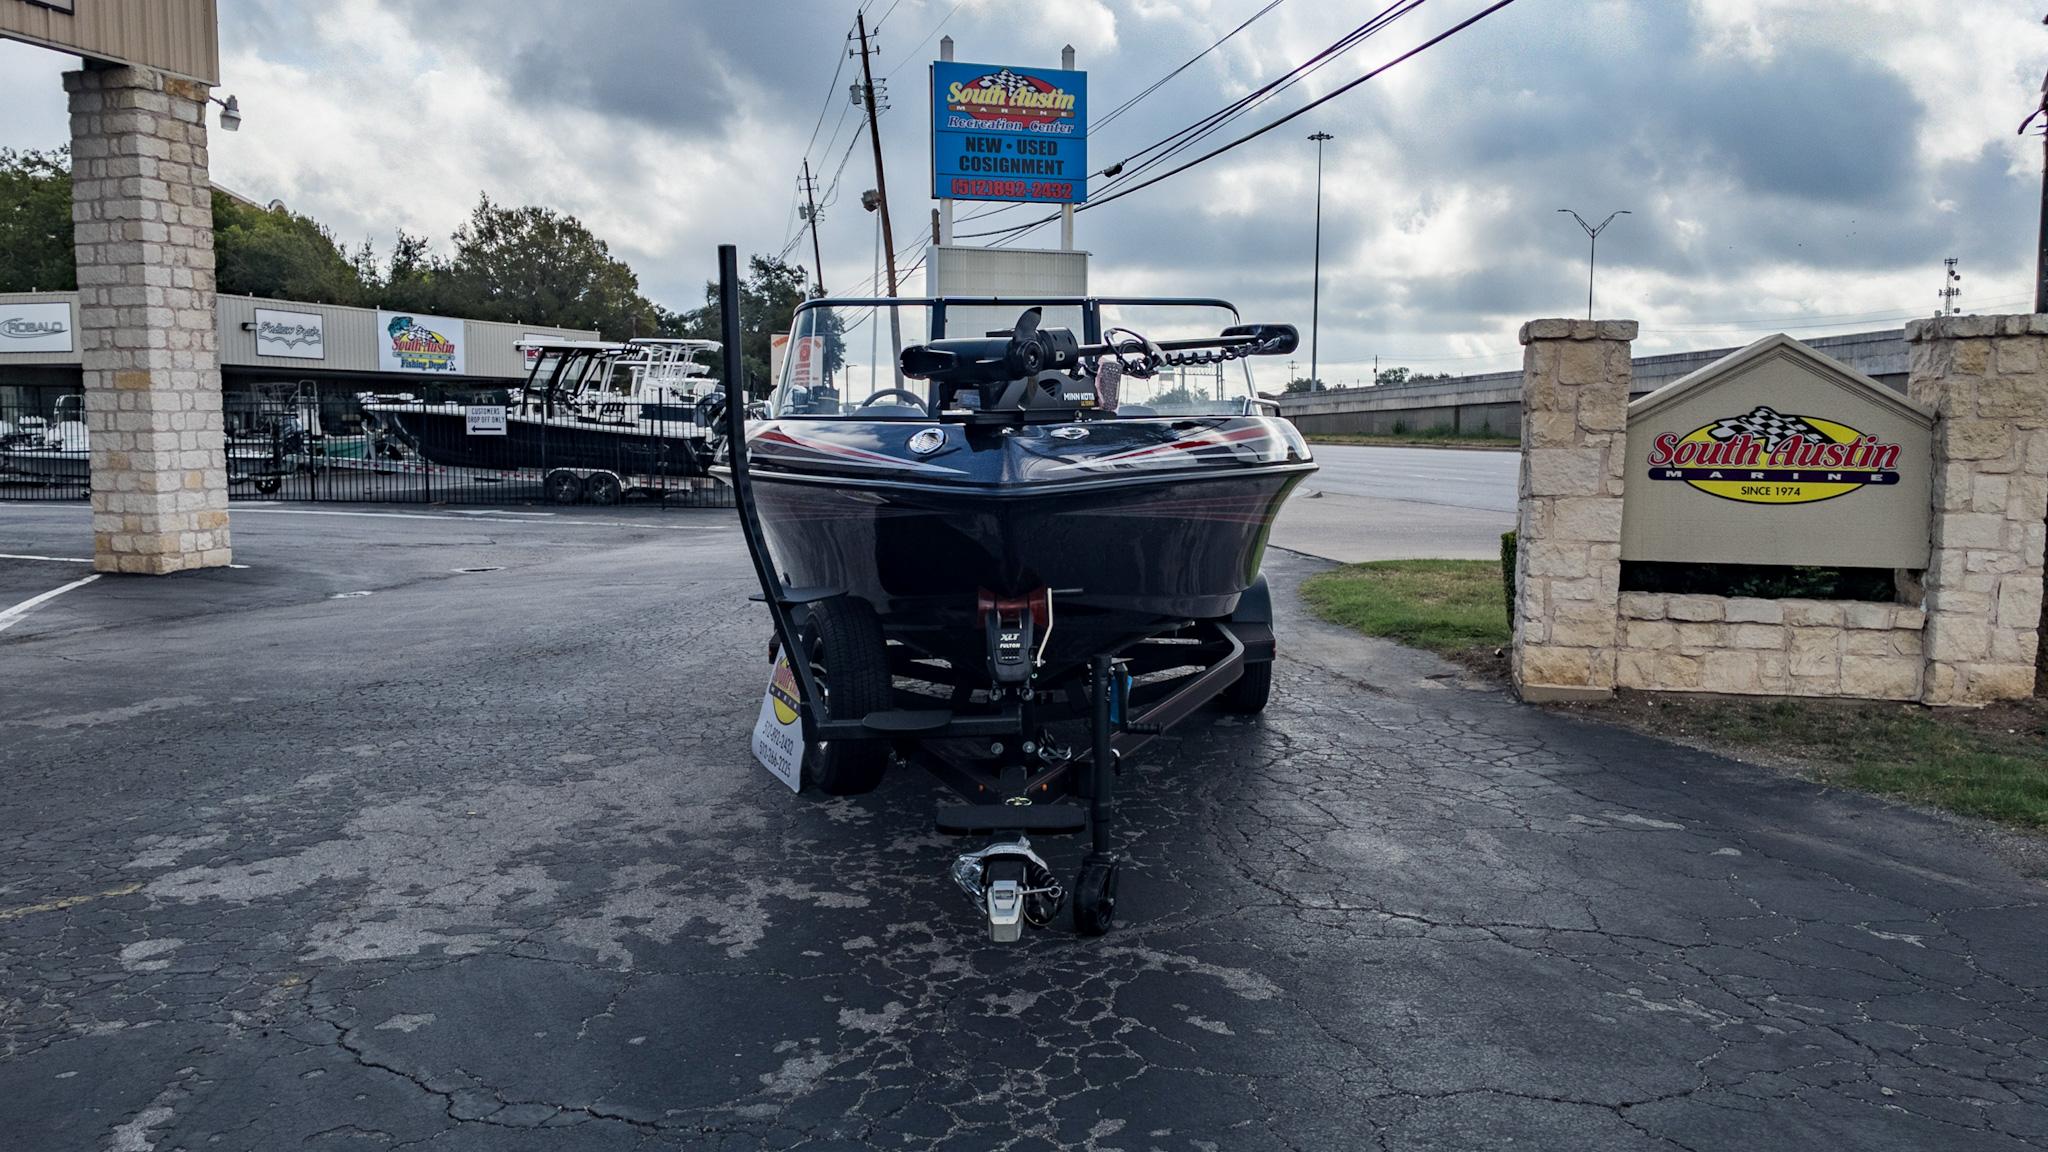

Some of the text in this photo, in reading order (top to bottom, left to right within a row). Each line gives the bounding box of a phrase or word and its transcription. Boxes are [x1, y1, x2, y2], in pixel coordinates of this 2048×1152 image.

[947, 81, 1075, 110] South Austin
[956, 105, 1067, 117] MARINE
[948, 116, 1074, 133] Recreation Center
[965, 137, 1057, 156] NEW USED
[959, 156, 1064, 175] COSIGNMENT
[952, 178, 1072, 199] (512)892-2432
[8, 321, 63, 333] ROBALO
[392, 336, 455, 354] South Austin
[401, 358, 448, 372] Fishing Depot
[1063, 393, 1095, 401] MINN KOTA
[491, 416, 505, 424] ONLY
[1648, 432, 1902, 469] South Austin
[1665, 470, 1883, 482] MARINE
[1740, 486, 1801, 497] SINCE 1974
[1000, 633, 1020, 641] XLT
